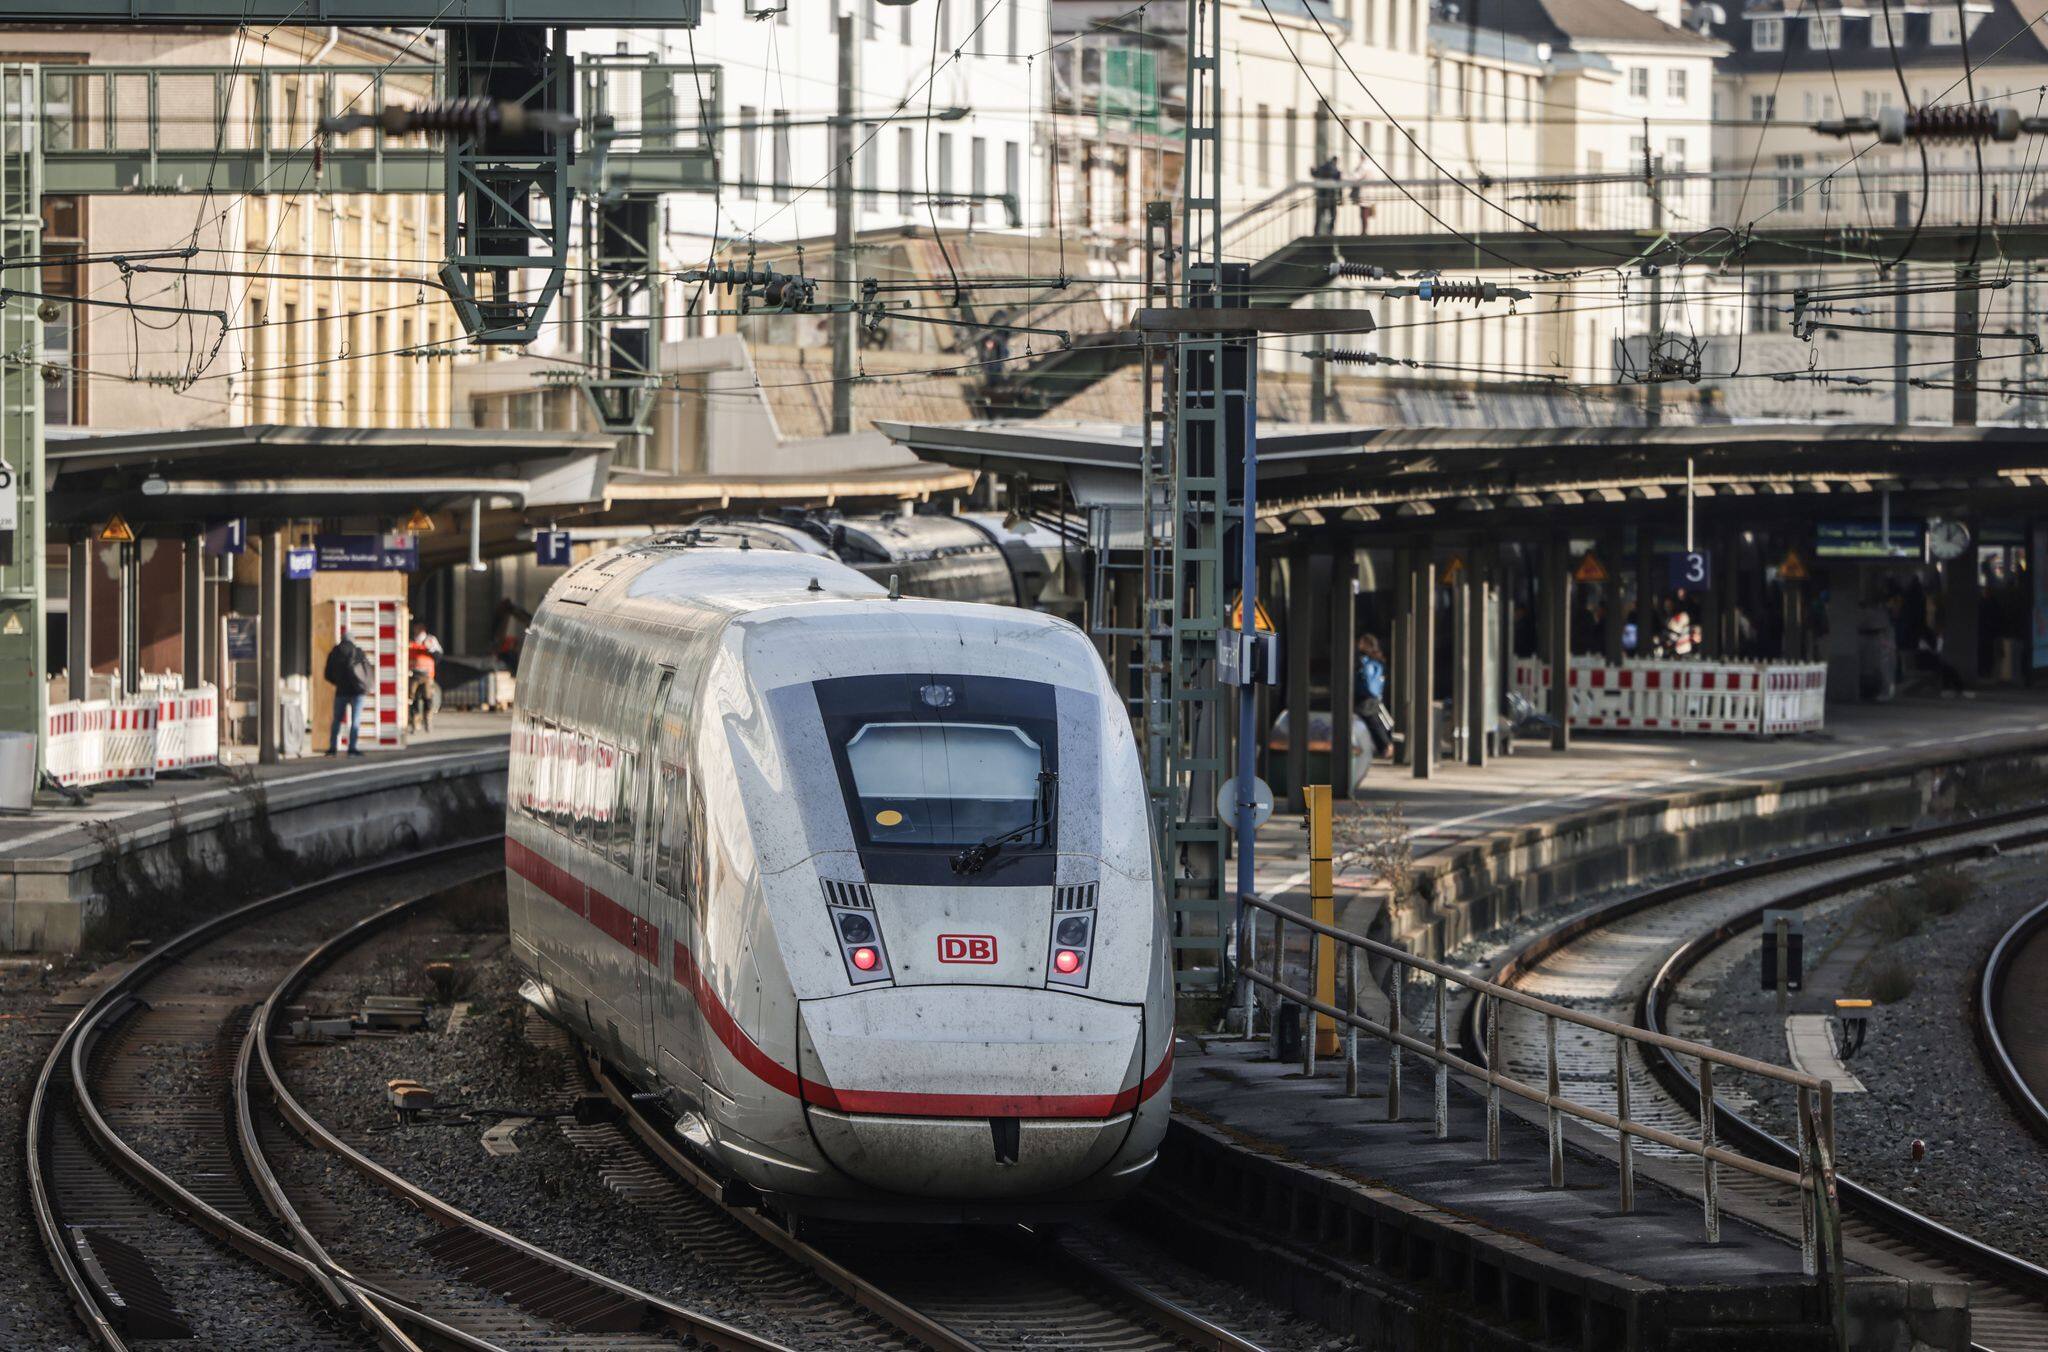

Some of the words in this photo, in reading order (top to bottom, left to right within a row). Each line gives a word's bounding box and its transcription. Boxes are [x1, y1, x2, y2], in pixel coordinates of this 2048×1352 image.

[228, 518, 241, 547] 1
[550, 533, 566, 560] F
[1686, 553, 1705, 583] 3
[944, 938, 992, 960] DB
